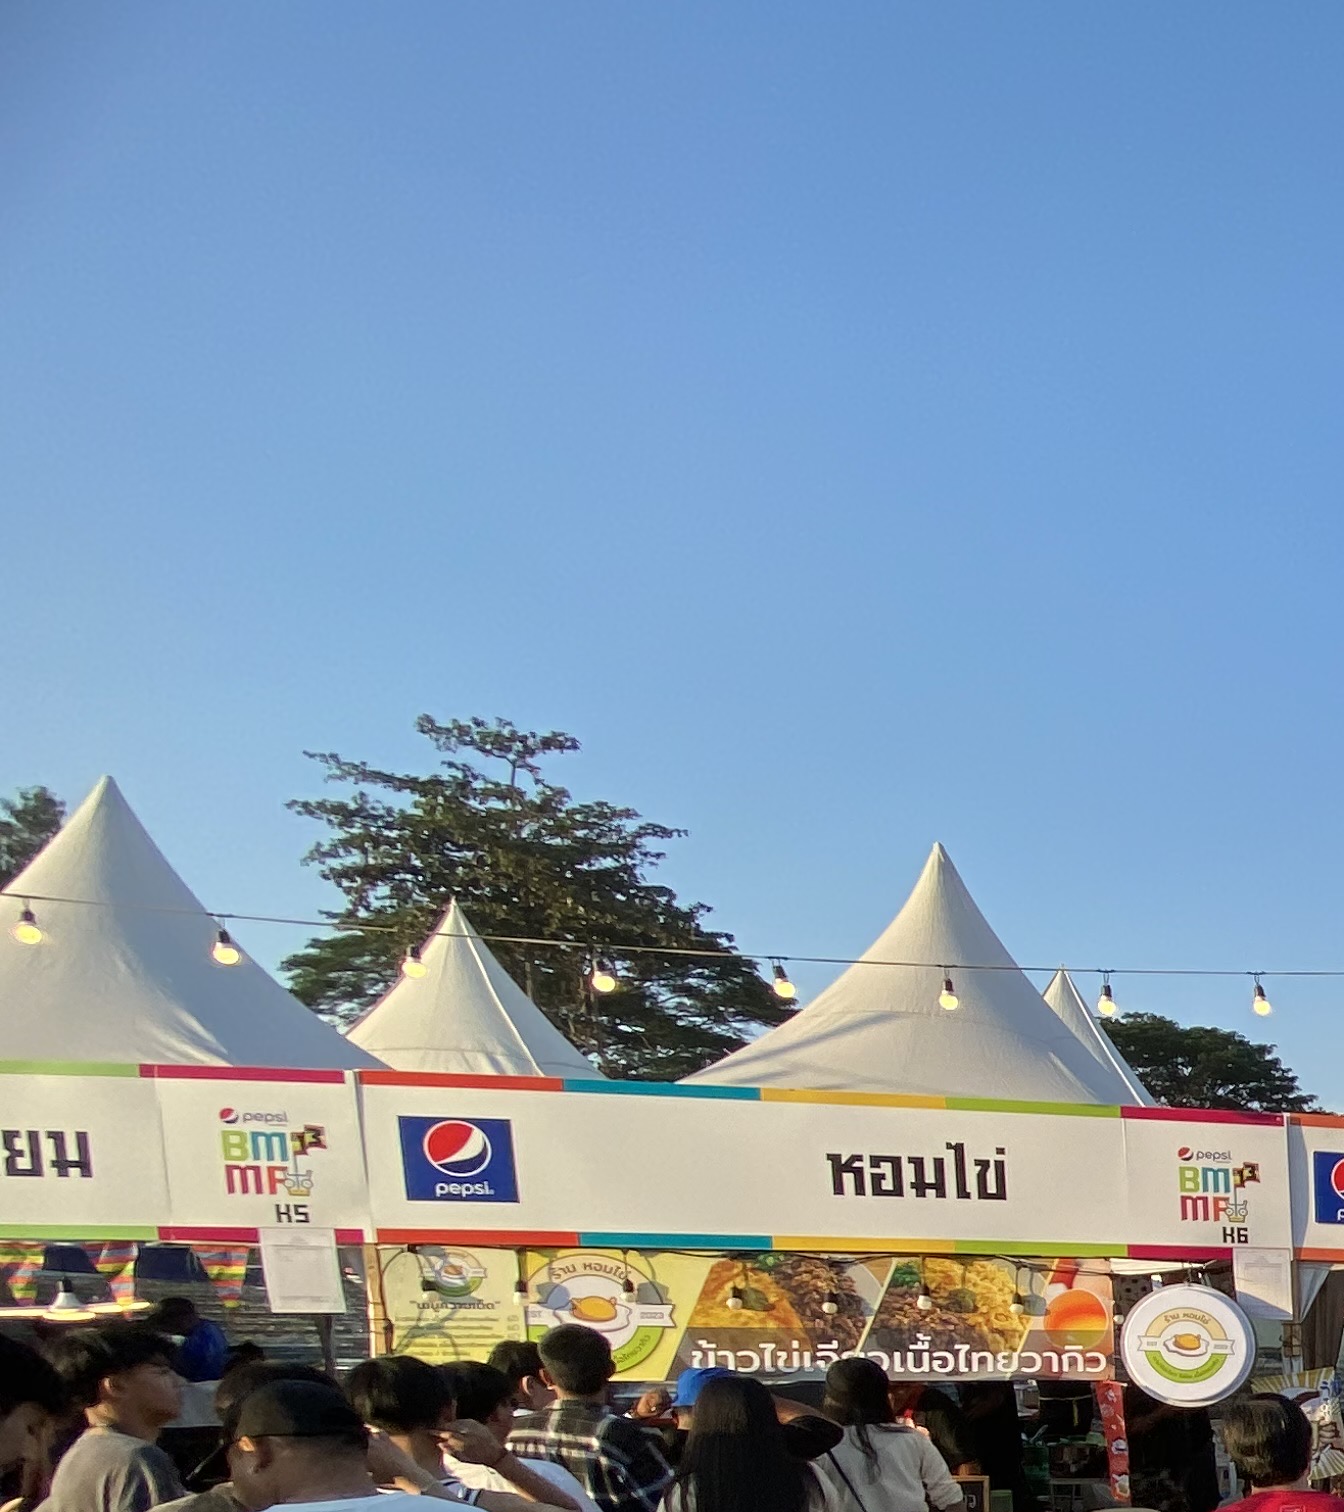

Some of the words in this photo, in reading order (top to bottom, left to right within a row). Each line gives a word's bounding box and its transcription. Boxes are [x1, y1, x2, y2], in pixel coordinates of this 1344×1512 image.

[242, 1110, 289, 1124] pepsi
[1196, 1150, 1232, 1162] pepsi
[825, 1142, 1008, 1201] หอมไข่
[435, 1181, 490, 1198] pepsi
